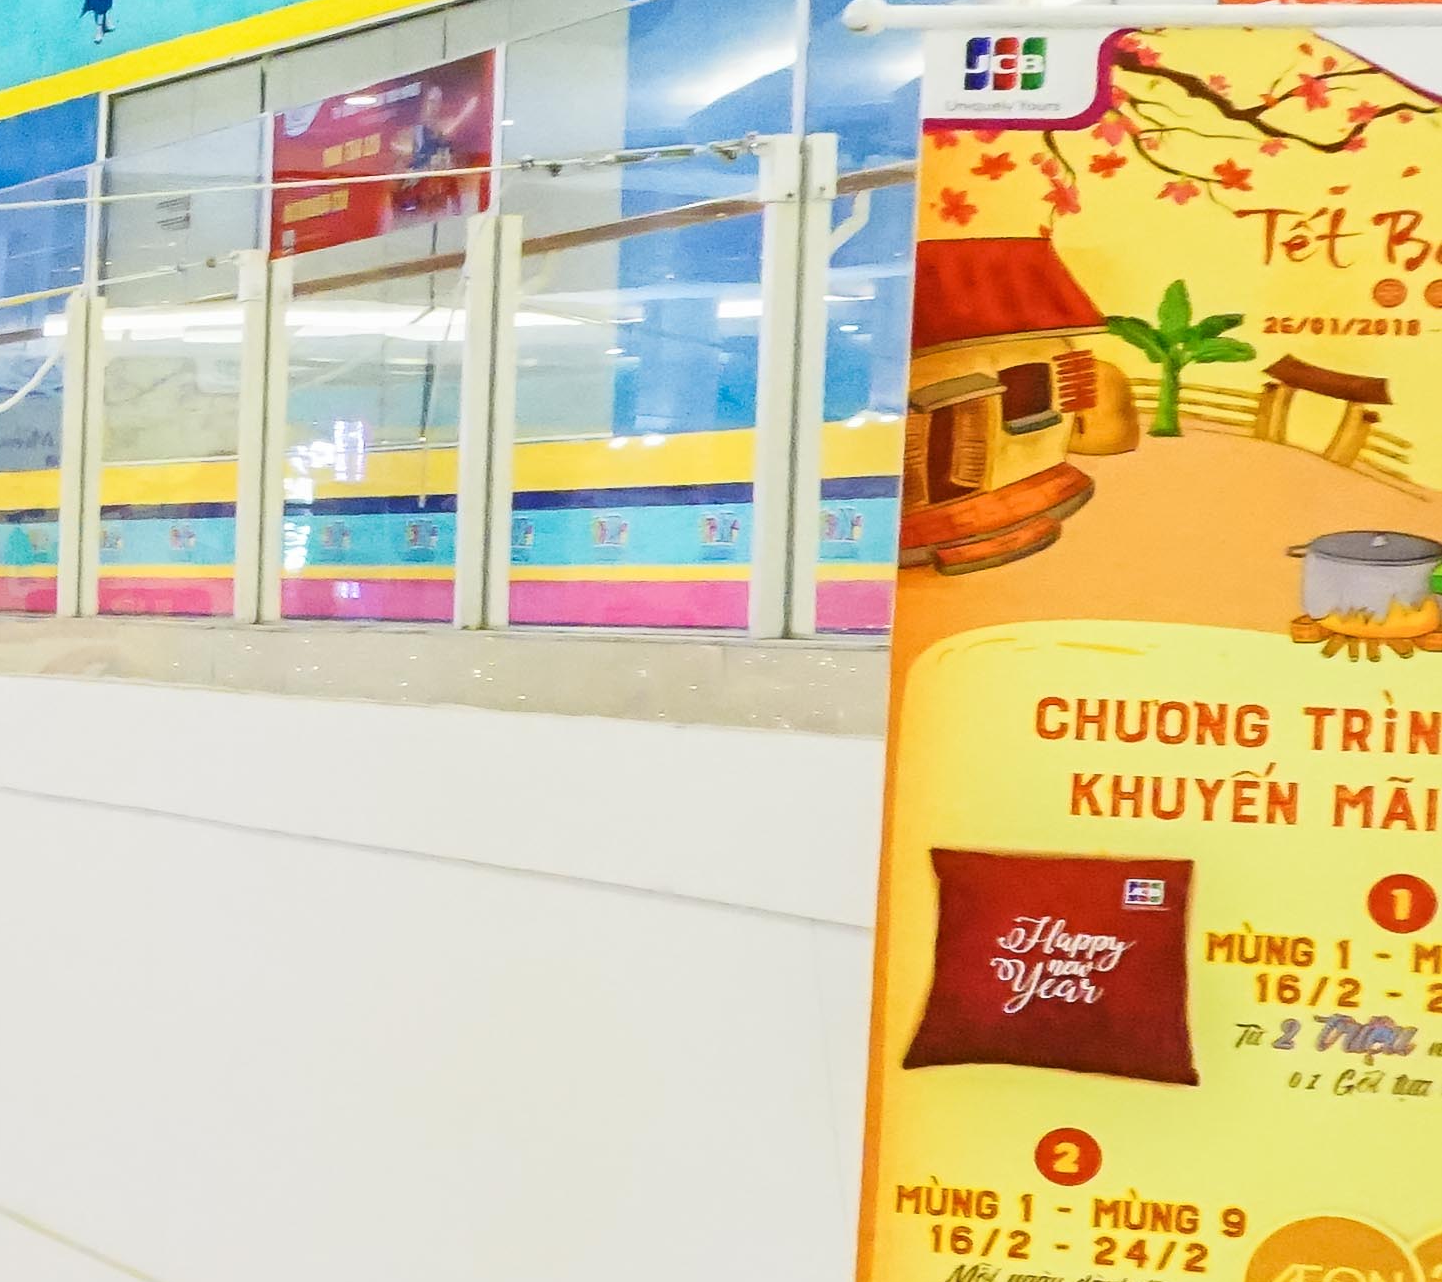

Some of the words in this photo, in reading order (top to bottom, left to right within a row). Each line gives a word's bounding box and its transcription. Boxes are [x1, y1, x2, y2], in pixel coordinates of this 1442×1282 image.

[964, 36, 1047, 91] JCB
[944, 98, 1014, 116] Uniquely
[1016, 99, 1062, 115] Yours
[1233, 206, 1363, 269] Tết
[1303, 690, 1442, 756] TRÌN
[1070, 761, 1300, 826] KHUYẾN
[1331, 775, 1440, 832] MÃI
[1390, 888, 1413, 921] 1
[998, 916, 1138, 973] Happy
[1205, 922, 1314, 968] MÙNG
[1337, 939, 1352, 970] 1
[990, 956, 1104, 1015] Year
[1255, 973, 1362, 1008] 16/2
[1271, 1018, 1301, 1051] 2
[1052, 1142, 1082, 1175] 2
[895, 1174, 999, 1222] MÙNG
[1020, 1192, 1036, 1222] 1
[1093, 1188, 1200, 1236] MÙNG
[1219, 1208, 1248, 1239] 9
[928, 1223, 1033, 1261] 16/2
[1093, 1236, 1210, 1274] 24/2
